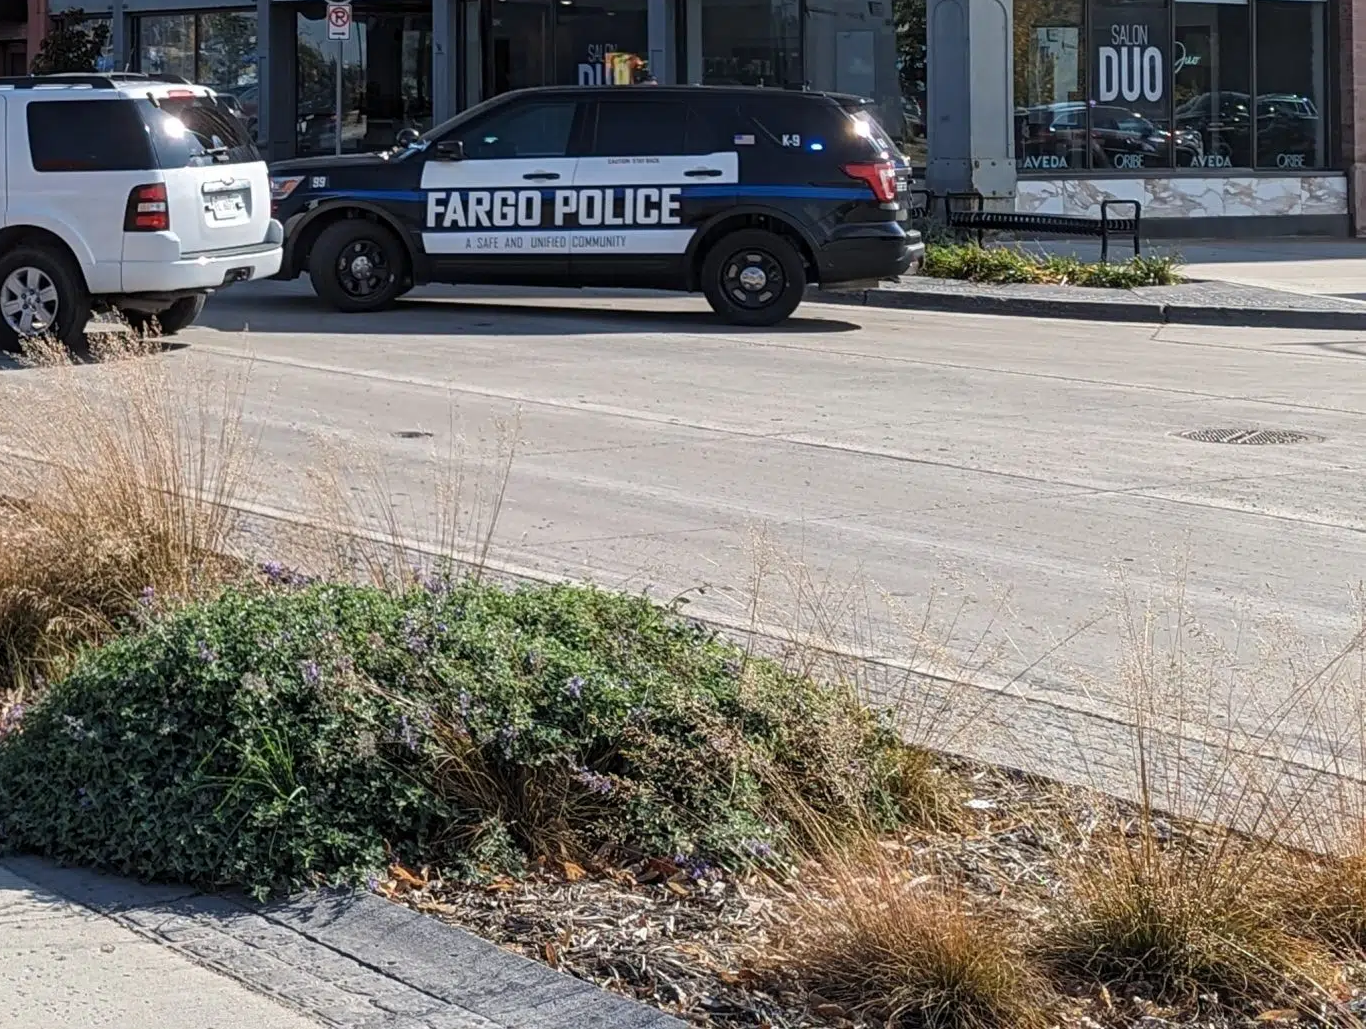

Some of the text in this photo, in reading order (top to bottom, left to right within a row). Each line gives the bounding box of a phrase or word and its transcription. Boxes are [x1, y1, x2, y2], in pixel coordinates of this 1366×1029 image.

[1111, 24, 1148, 45] SALON
[1099, 46, 1163, 102] DUO
[781, 134, 801, 147] K-9
[1023, 155, 1068, 169] AVEDA
[1114, 153, 1145, 169] ORIBE
[1190, 155, 1233, 168] AVEDA
[1276, 153, 1306, 168] ORIBE
[312, 176, 326, 188] 99
[426, 187, 682, 227] FARGO POLICE
[465, 235, 627, 249] A SAFE AND UNIFIED COMMUNITY
